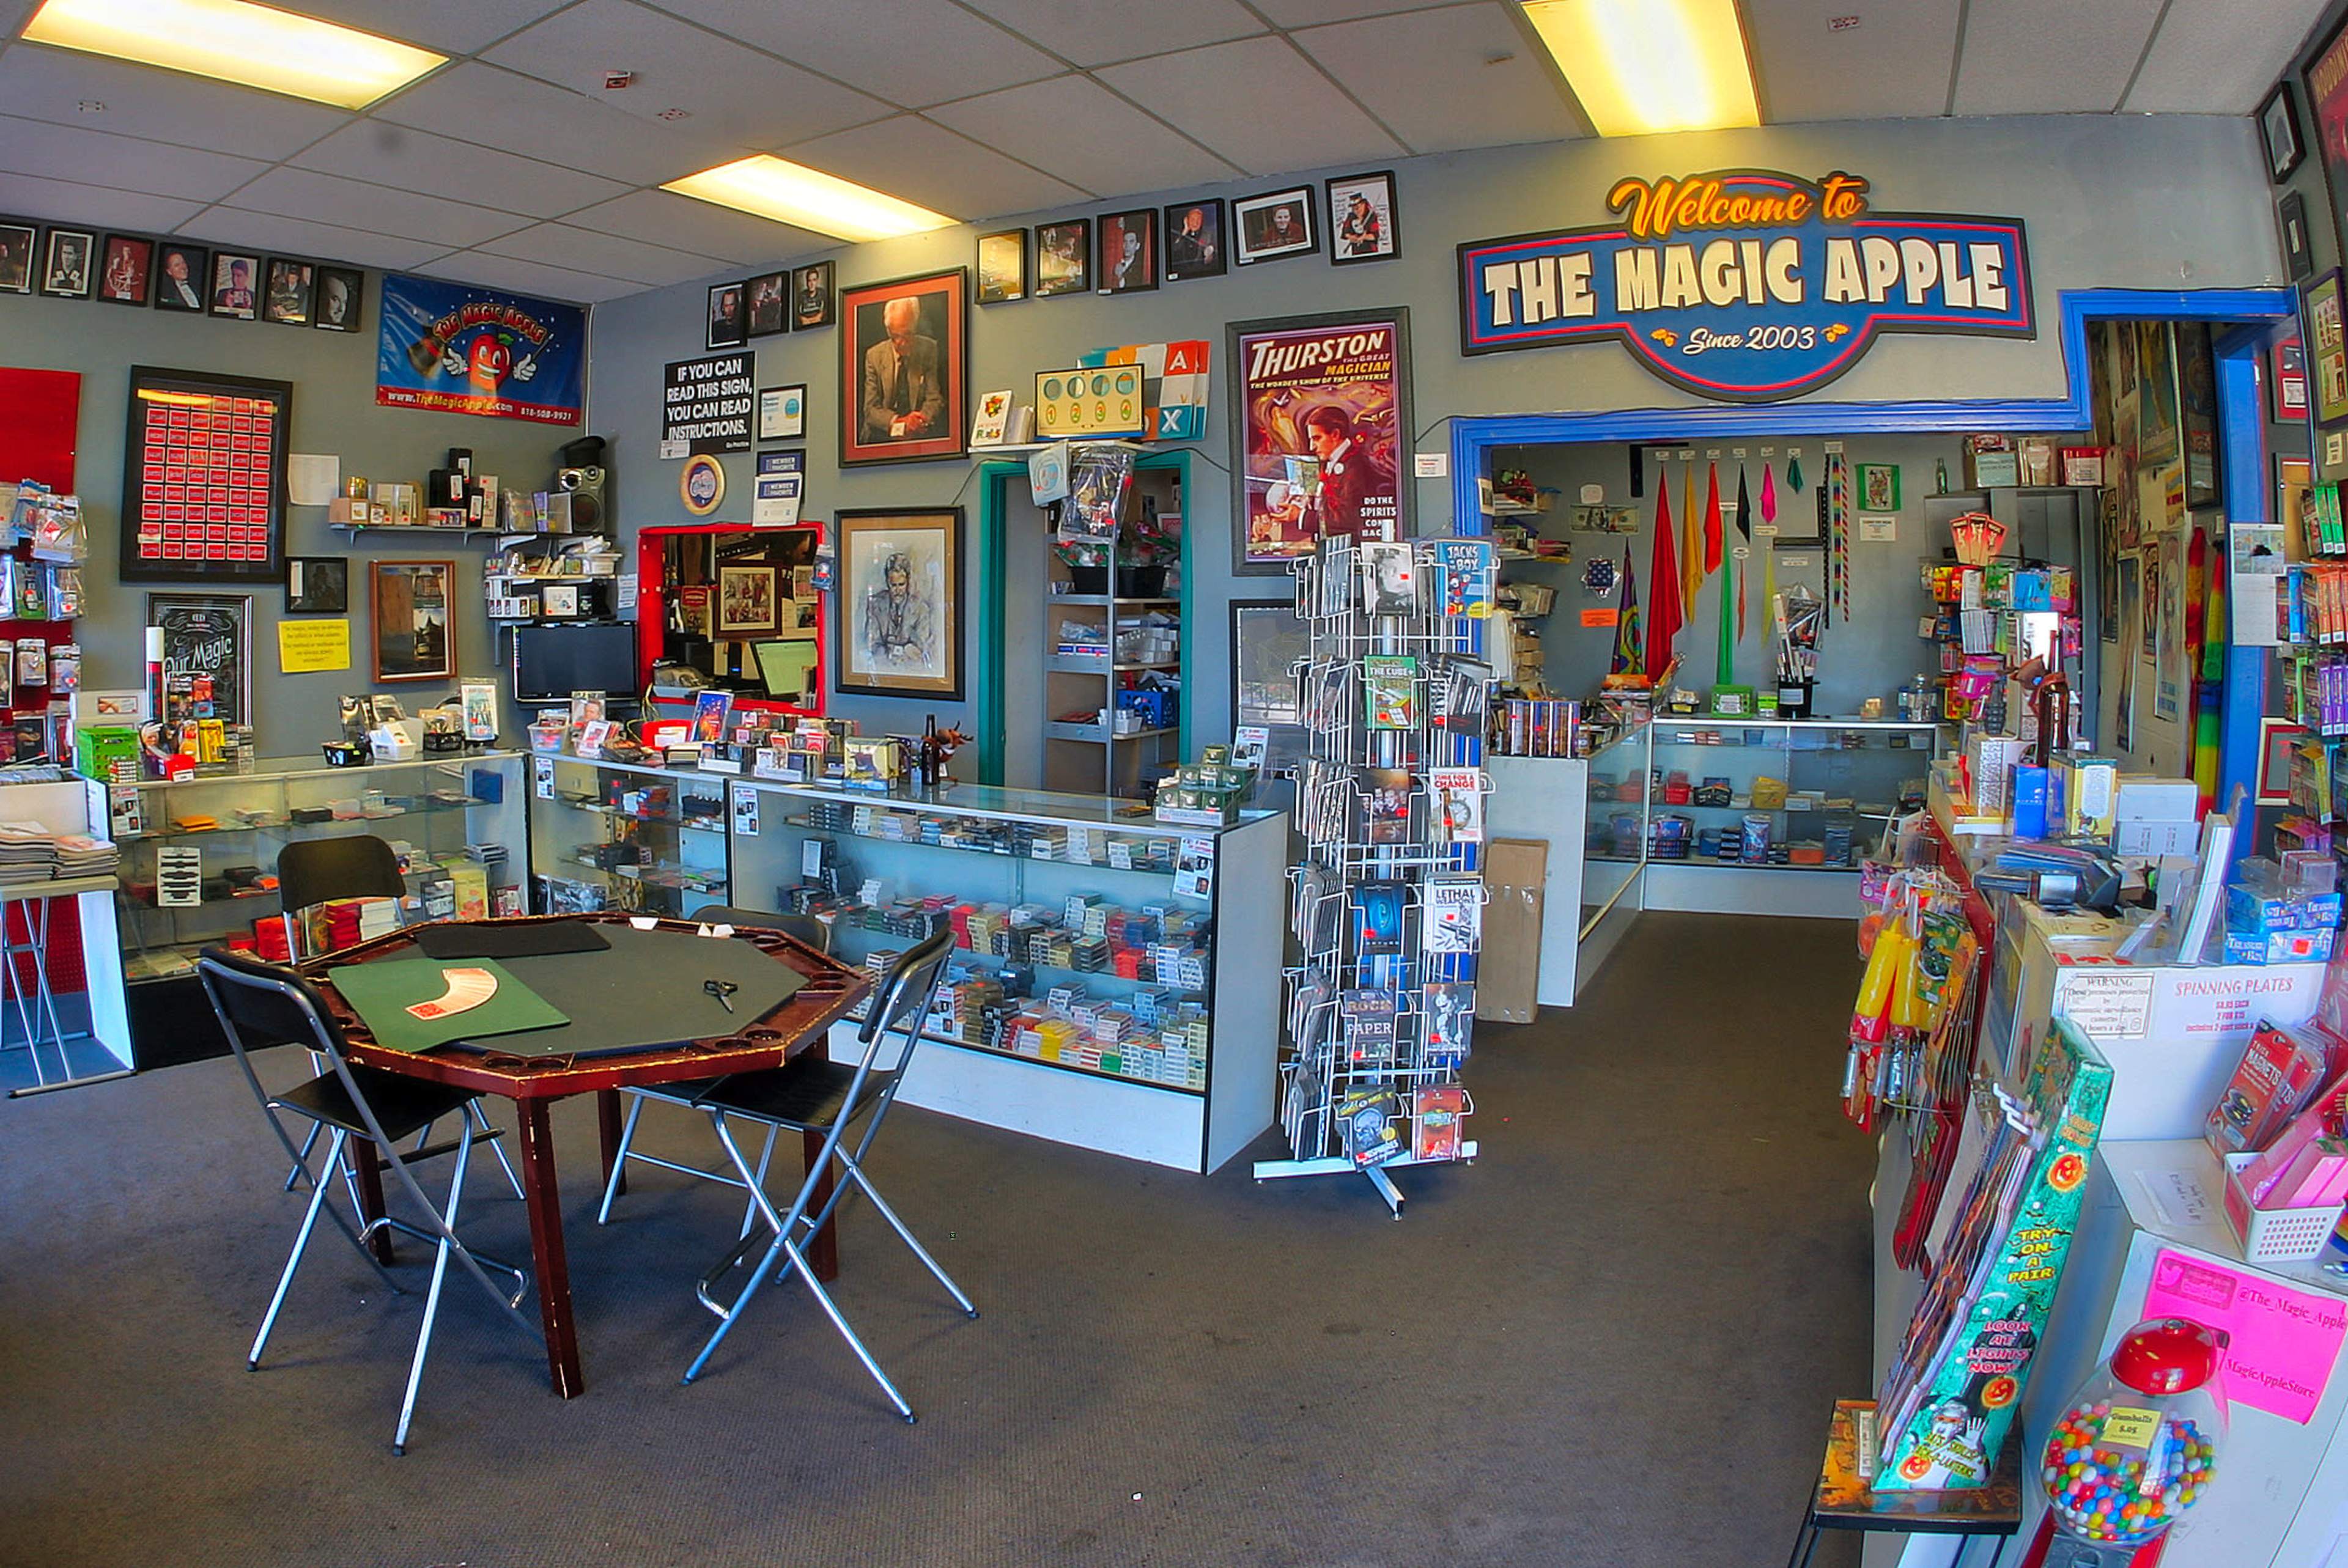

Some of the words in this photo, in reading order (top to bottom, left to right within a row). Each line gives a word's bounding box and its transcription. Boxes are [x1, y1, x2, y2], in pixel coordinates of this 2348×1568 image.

[1611, 179, 1811, 237] Welcome
[1823, 176, 1863, 217] to
[1485, 252, 1594, 326] THE
[1615, 238, 1804, 312] MAGIC
[1822, 236, 2009, 311] APPLE
[433, 312, 460, 342] THE
[461, 303, 503, 329] MAGIC
[503, 306, 547, 345] APPLE
[1682, 328, 1743, 355] Since
[1745, 325, 1815, 351] 2003
[1169, 350, 1187, 371] A
[1249, 331, 1386, 381] THURSTON
[1359, 353, 1390, 362] GREAT
[677, 367, 688, 382] IF
[689, 363, 713, 380] YOU
[715, 358, 742, 376] CAN
[1324, 361, 1391, 376] MAGICIAN
[667, 384, 694, 402] READ
[696, 381, 720, 399] THIS
[721, 377, 753, 397] SIGN,
[1266, 379, 1298, 389] WONDER
[1299, 377, 1321, 386] SHOW
[1349, 372, 1390, 382] UNIVERSE
[667, 405, 692, 422] YOU
[693, 402, 719, 419] CAN
[721, 398, 751, 416] READ
[668, 419, 748, 441] INSTRUCTIONS.
[1360, 506, 1397, 517] SPIRITS
[1447, 546, 1479, 559] JACKS
[1456, 558, 1479, 572] BOX
[192, 636, 233, 670] Magic
[1434, 780, 1475, 789] CHANGE
[2087, 977, 2133, 987] WARNING
[2175, 979, 2241, 996] SPINNING
[2245, 977, 2293, 993] PLATES
[1347, 1022, 1392, 1035] PAPER
[2245, 1048, 2283, 1086] MAGNETS
[2018, 1228, 2058, 1241] TRY
[2020, 1241, 2051, 1254] ON
[2026, 1256, 2039, 1267] A
[2007, 1266, 2055, 1284] PAIR
[2239, 1286, 2346, 1330] @The_Magic_Apple
[1983, 1320, 2032, 1333] LOOK
